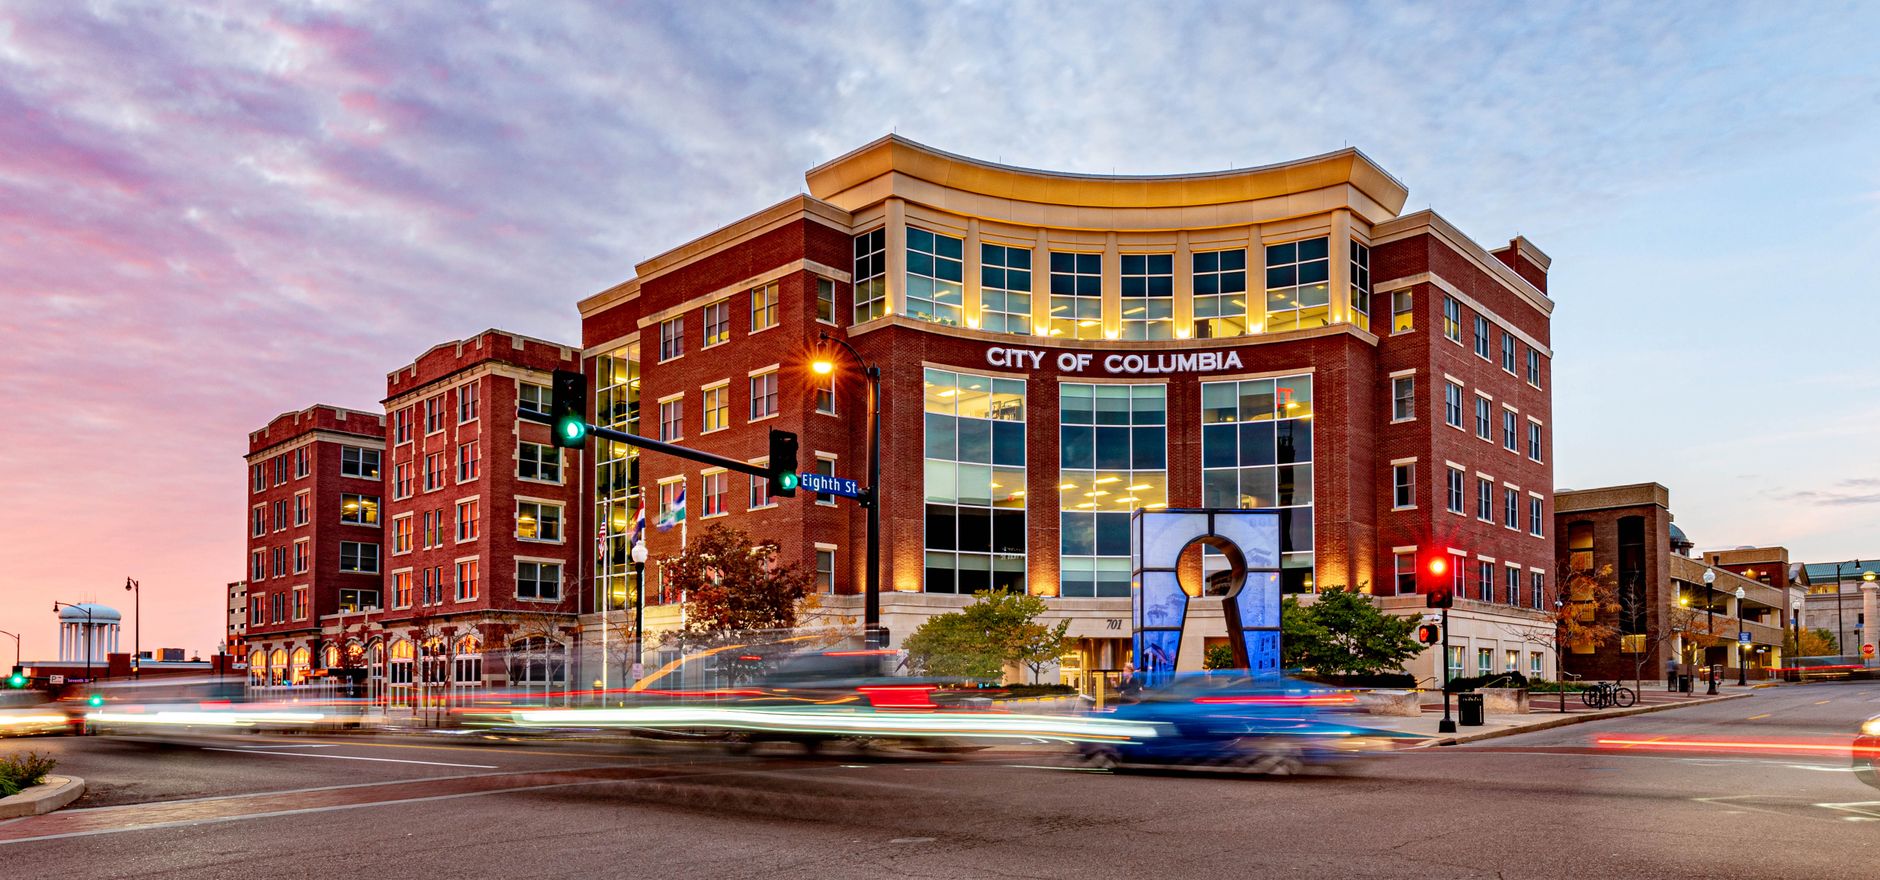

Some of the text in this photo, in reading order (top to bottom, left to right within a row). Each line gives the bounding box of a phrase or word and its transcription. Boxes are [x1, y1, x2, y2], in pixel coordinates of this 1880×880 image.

[986, 346, 1243, 374] CITY OF COLUMBIA
[802, 474, 857, 494] Eighth St
[1106, 619, 1122, 630] 701
